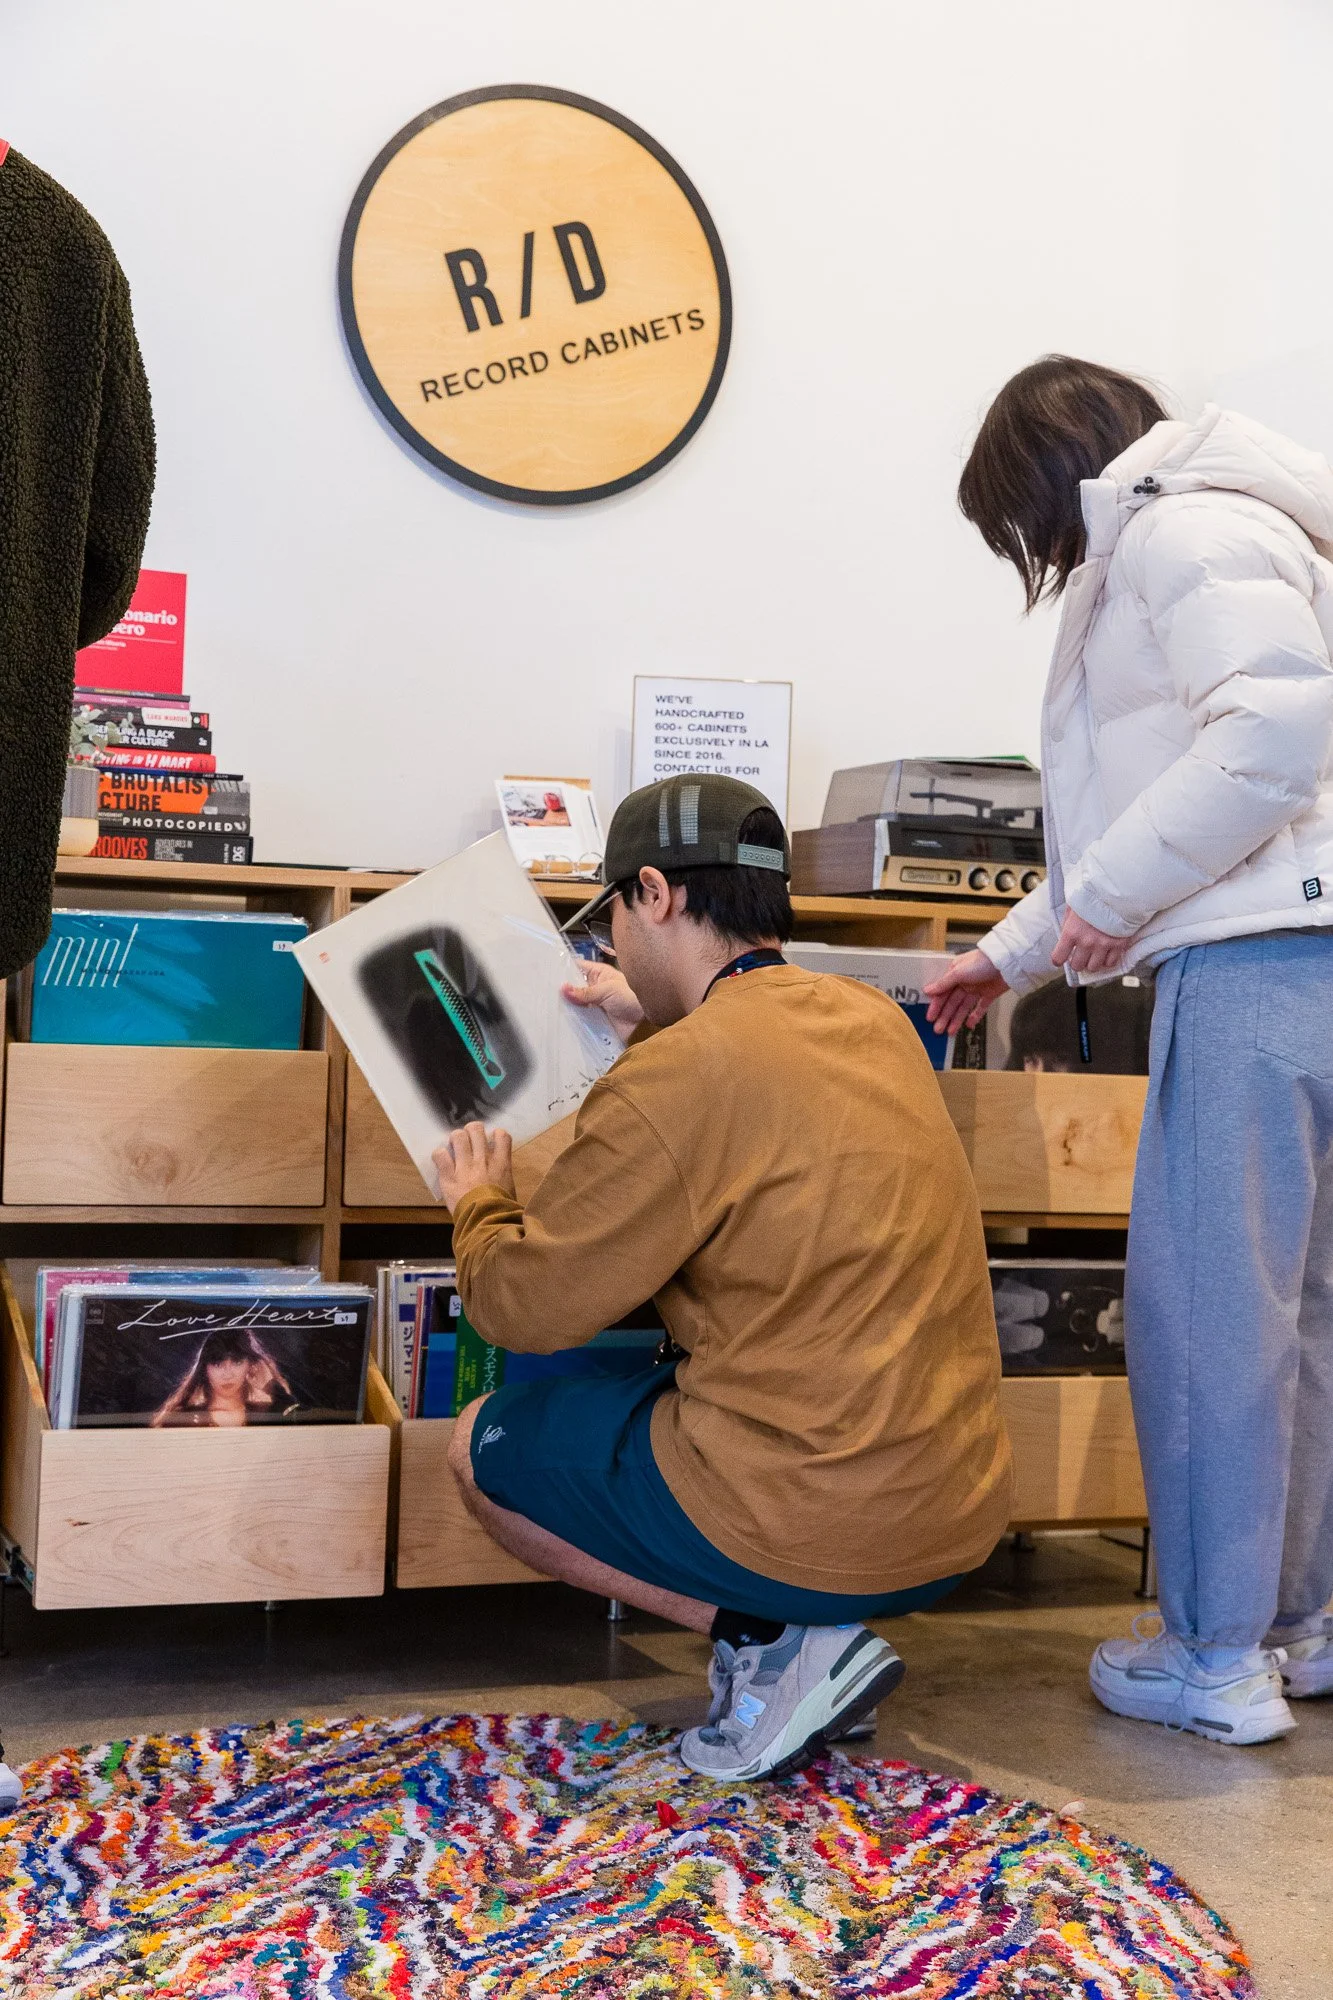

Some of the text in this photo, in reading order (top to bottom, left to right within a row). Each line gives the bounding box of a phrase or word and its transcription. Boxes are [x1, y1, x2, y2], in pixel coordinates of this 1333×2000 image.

[420, 308, 705, 402] RECORD CABINETS
[655, 695, 693, 704] WE'VE
[655, 709, 745, 720] HANDCRAFTED
[654, 723, 747, 734] 600+ CABINETS
[146, 729, 175, 740] BLACK
[131, 737, 169, 747] CULTURE
[654, 736, 769, 748] EXCLUSIVELY IN LA
[654, 750, 726, 760] SINCE 2016.
[145, 753, 158, 767] H
[158, 755, 194, 769] MART
[654, 764, 760, 775] CONTACT US FOR
[111, 774, 213, 795] BRUTALIST
[122, 817, 233, 832] PHOTOCOPIED
[117, 1299, 226, 1330] Love
[228, 1299, 342, 1327] Heart
